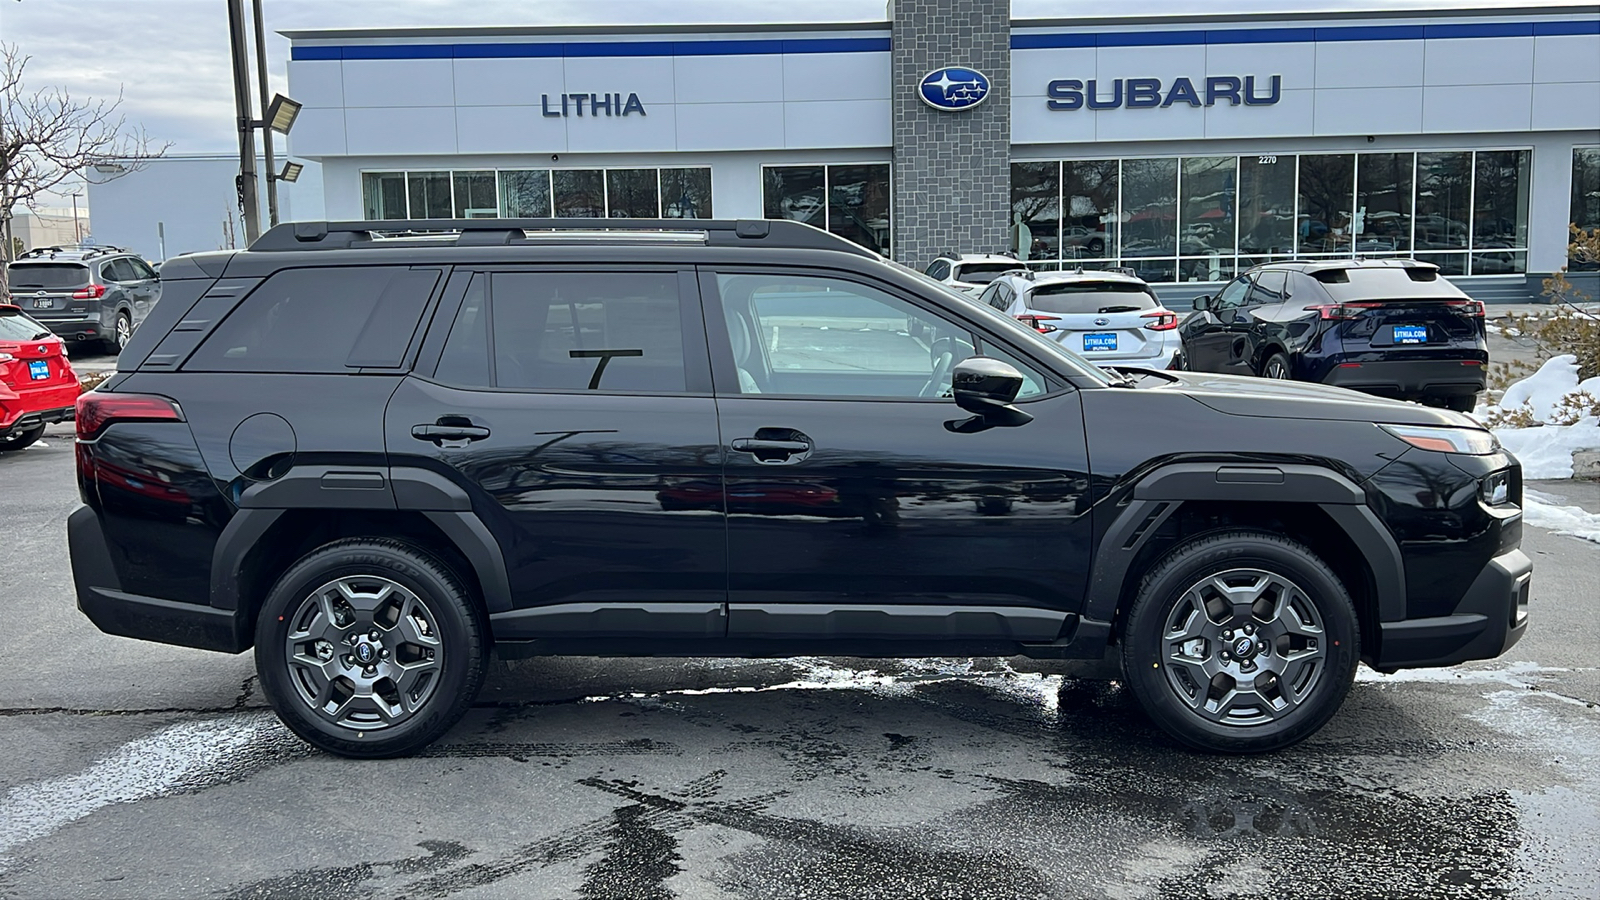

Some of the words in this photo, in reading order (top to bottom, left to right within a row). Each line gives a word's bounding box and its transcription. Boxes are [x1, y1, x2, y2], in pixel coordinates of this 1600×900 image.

[1047, 74, 1282, 110] SUBARU
[541, 92, 647, 117] LITHIA
[1258, 155, 1277, 164] 2270
[1084, 338, 1117, 346] LITHIA.COM
